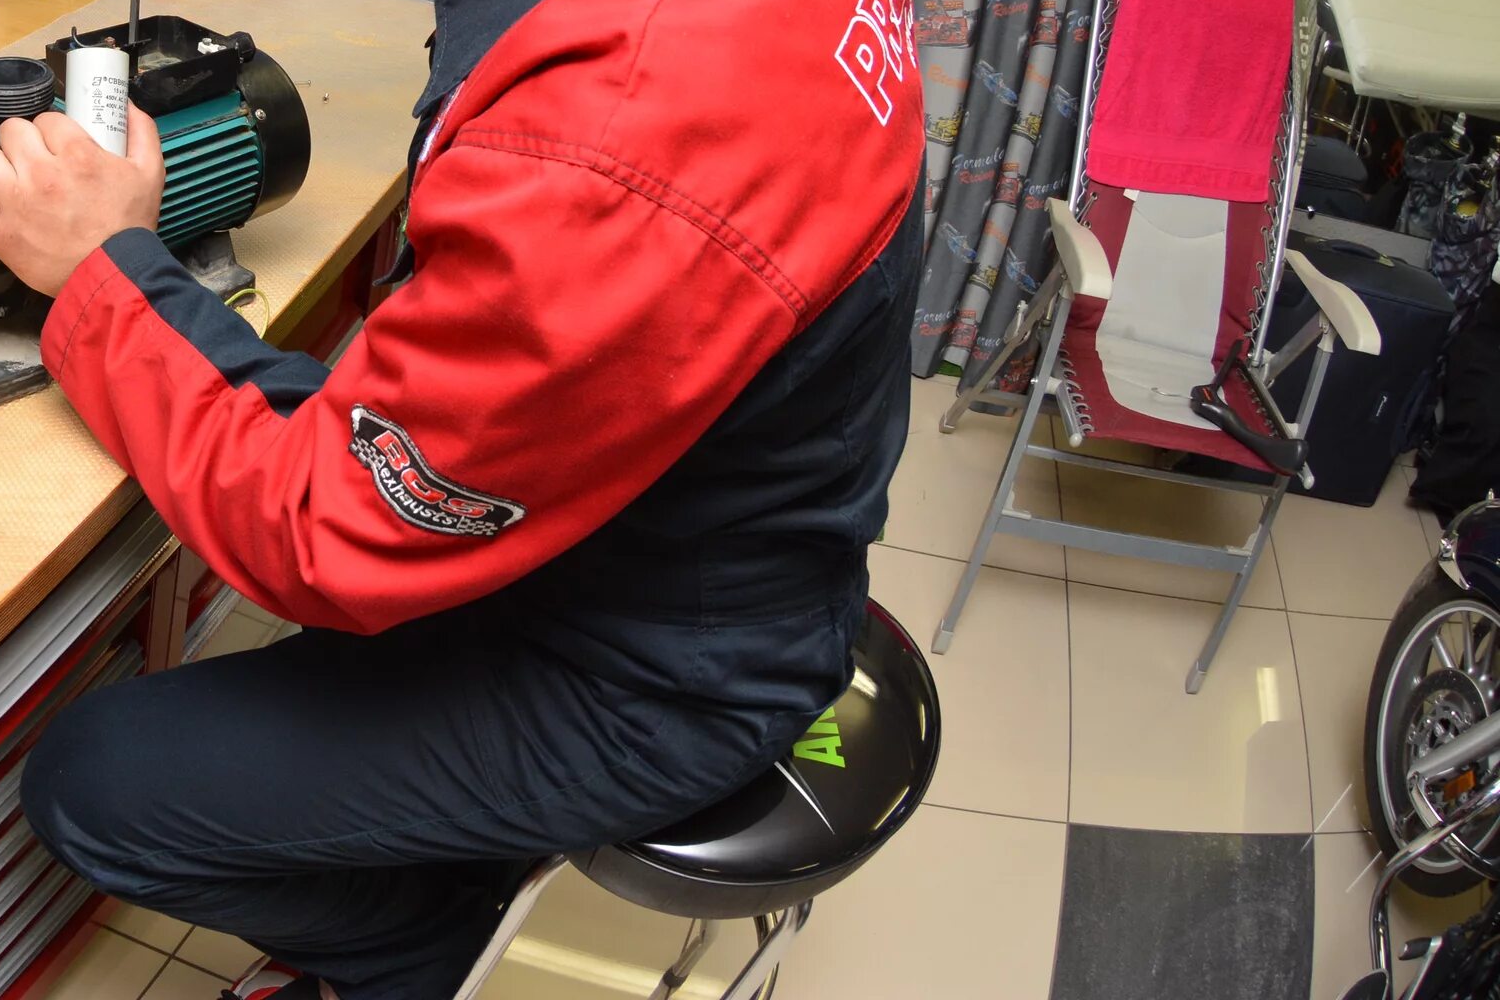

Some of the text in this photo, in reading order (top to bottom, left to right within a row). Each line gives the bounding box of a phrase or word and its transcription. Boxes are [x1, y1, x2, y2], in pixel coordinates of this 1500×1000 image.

[992, 2, 1029, 18] Racing
[372, 430, 494, 518] BOS
[380, 467, 458, 526] exhausts
